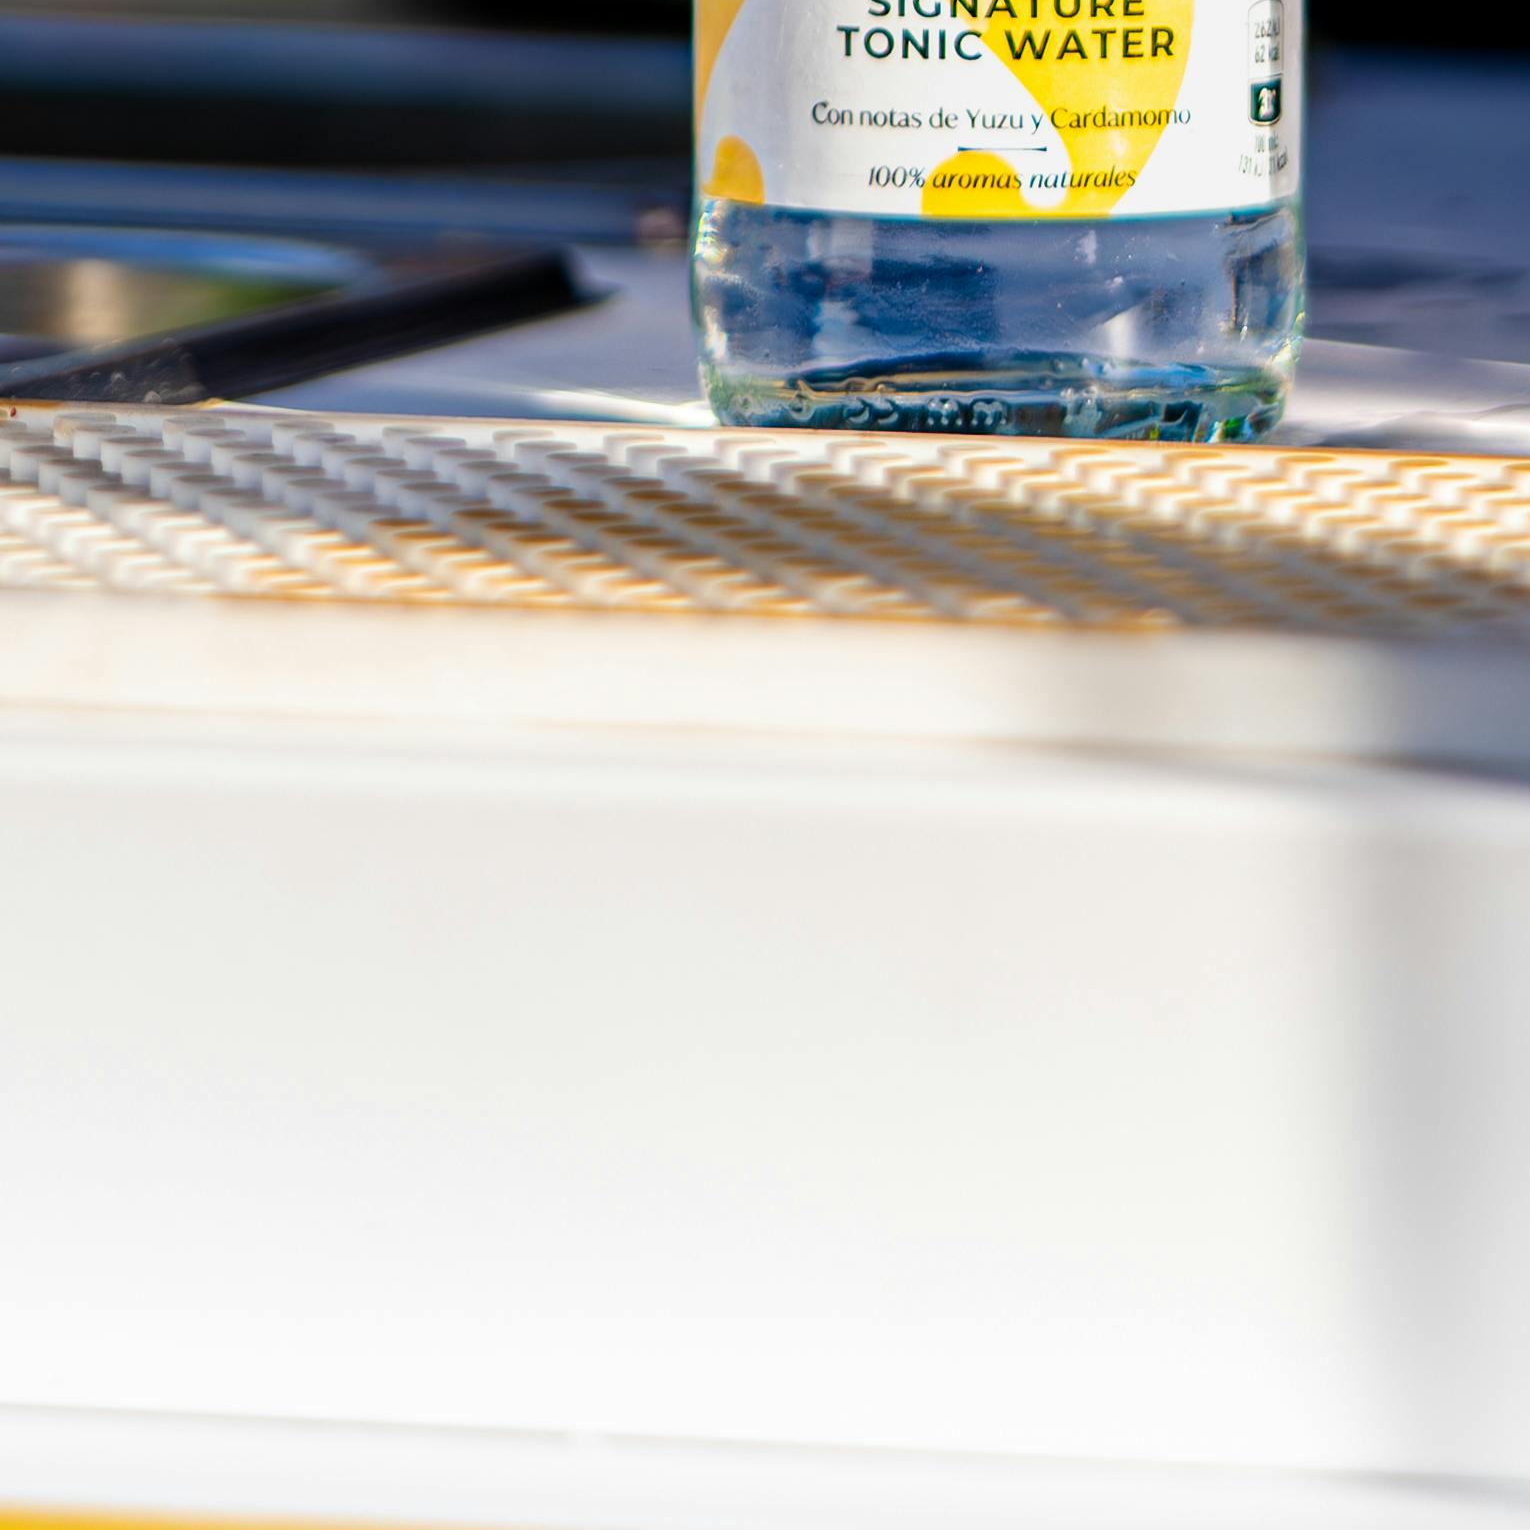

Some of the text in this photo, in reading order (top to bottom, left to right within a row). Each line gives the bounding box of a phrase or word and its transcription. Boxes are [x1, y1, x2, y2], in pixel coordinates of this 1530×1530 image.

[835, 25, 1176, 62] TONIC WATER
[811, 100, 1192, 135] Con notas de Yuzu y Cardamomo
[868, 166, 1137, 190] 100% aromas naturales
